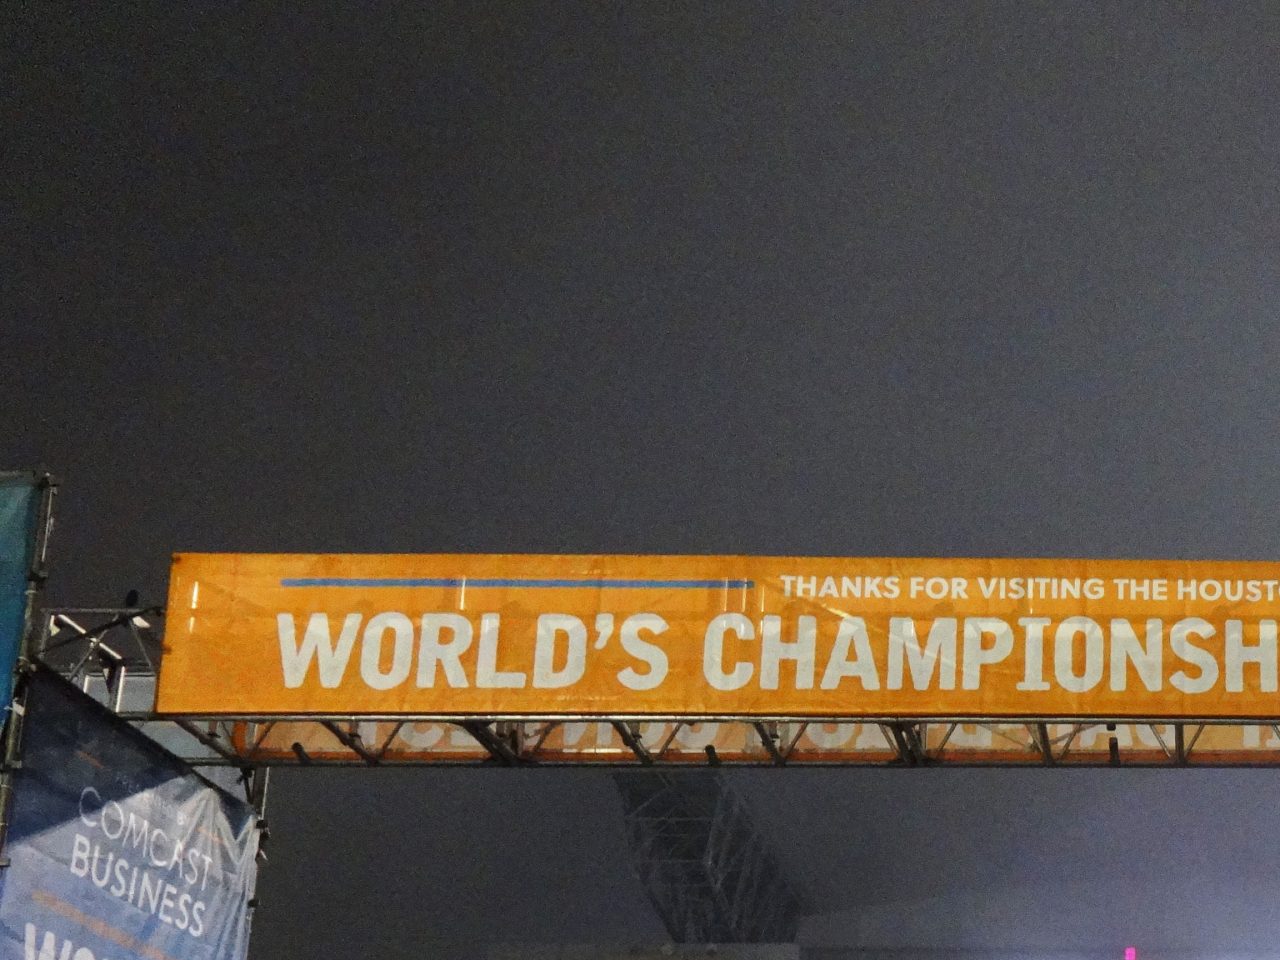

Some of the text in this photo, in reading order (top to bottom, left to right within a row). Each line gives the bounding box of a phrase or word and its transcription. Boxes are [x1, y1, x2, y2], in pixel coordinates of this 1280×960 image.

[780, 574, 900, 599] THANKS
[909, 577, 968, 600] FOR
[977, 578, 1105, 601] VISITING
[1117, 579, 1168, 602] THE
[276, 612, 669, 691] WORLD'S
[79, 787, 212, 891] COMCAST
[70, 833, 206, 937] BUSINESS
